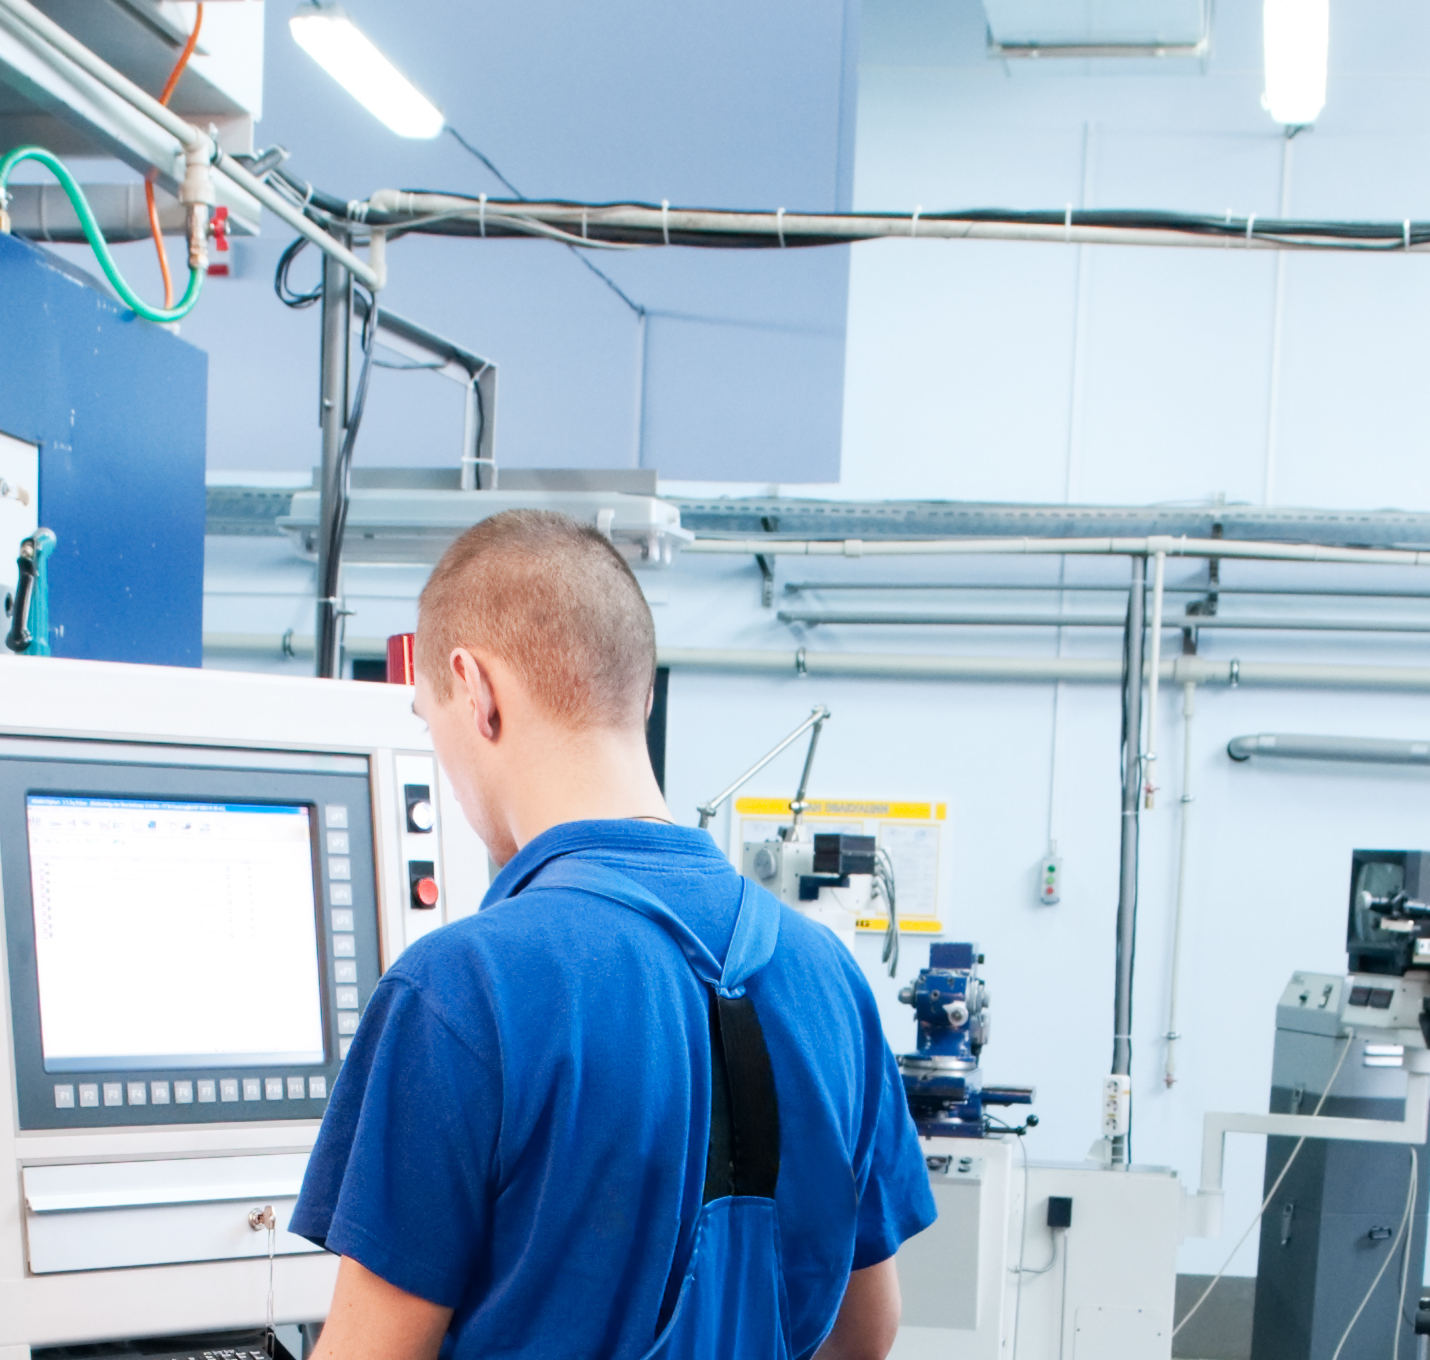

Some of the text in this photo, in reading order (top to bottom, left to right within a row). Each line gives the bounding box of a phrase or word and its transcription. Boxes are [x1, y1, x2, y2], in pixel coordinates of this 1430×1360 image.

[156, 1089, 165, 1097] F5
[268, 1085, 281, 1093] F10
[60, 1092, 69, 1100] F1
